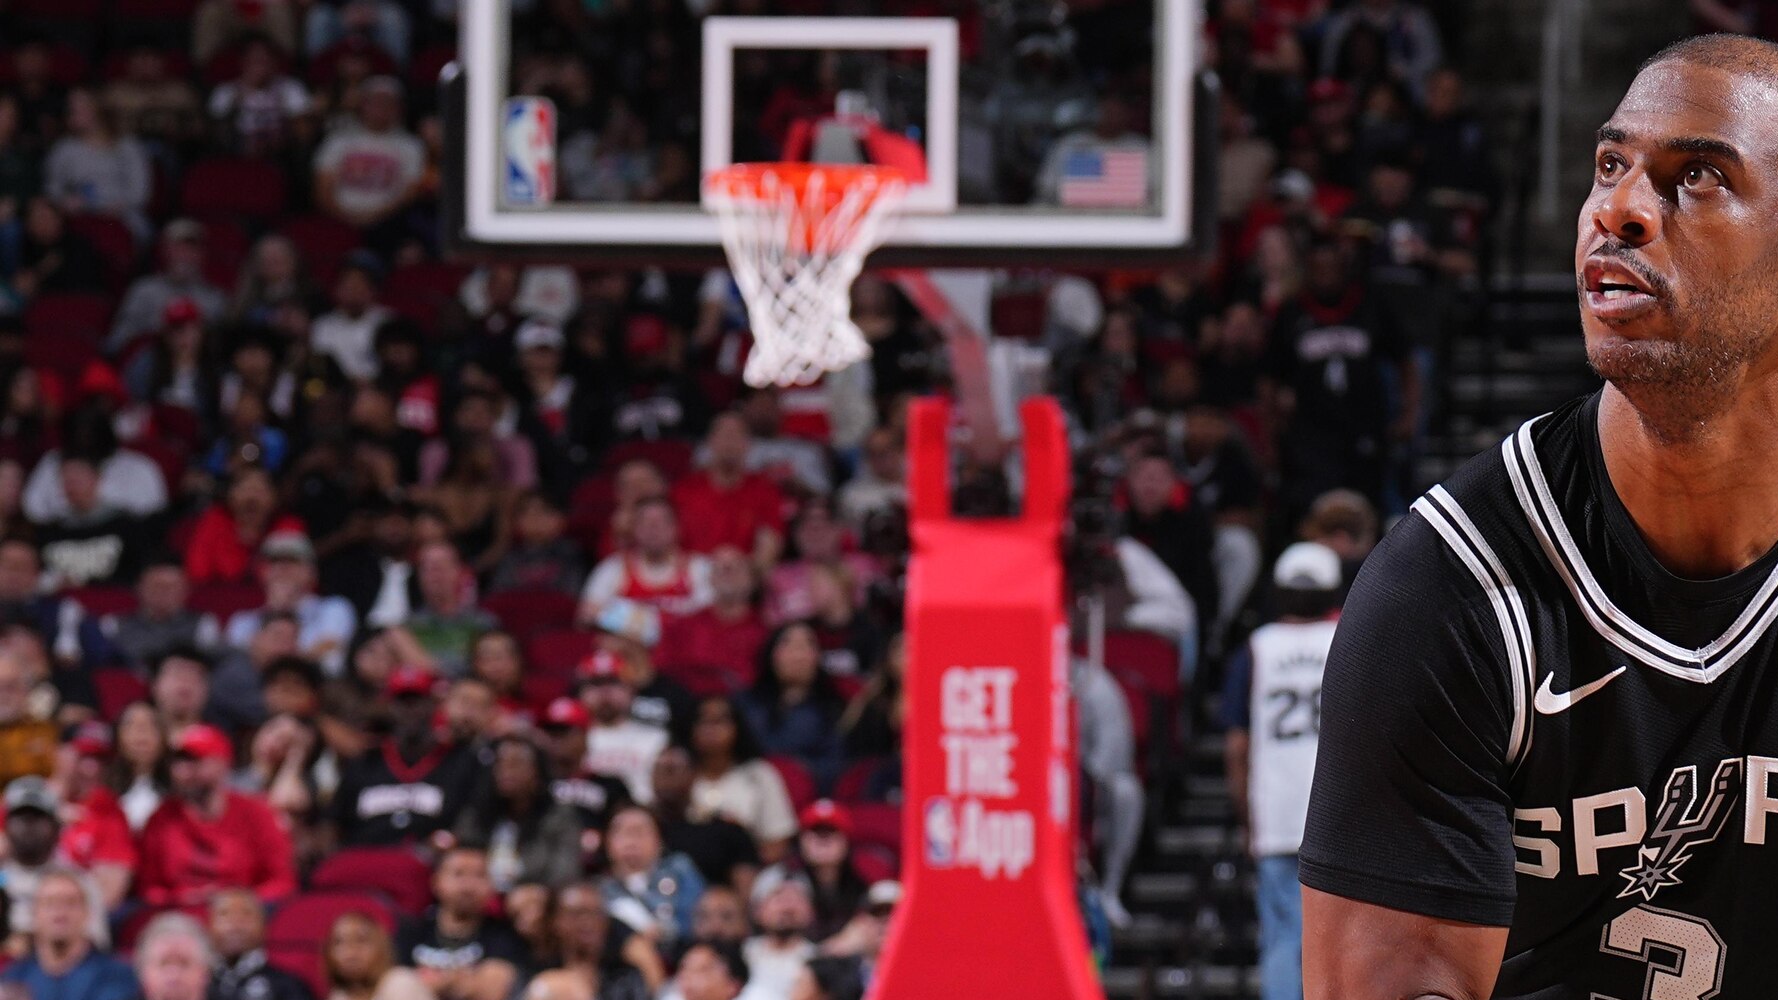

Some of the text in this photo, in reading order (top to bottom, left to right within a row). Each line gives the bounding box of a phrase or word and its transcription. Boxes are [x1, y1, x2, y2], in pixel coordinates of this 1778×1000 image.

[941, 666, 1018, 730] GET
[941, 732, 1018, 798] THE
[957, 798, 1035, 879] App
